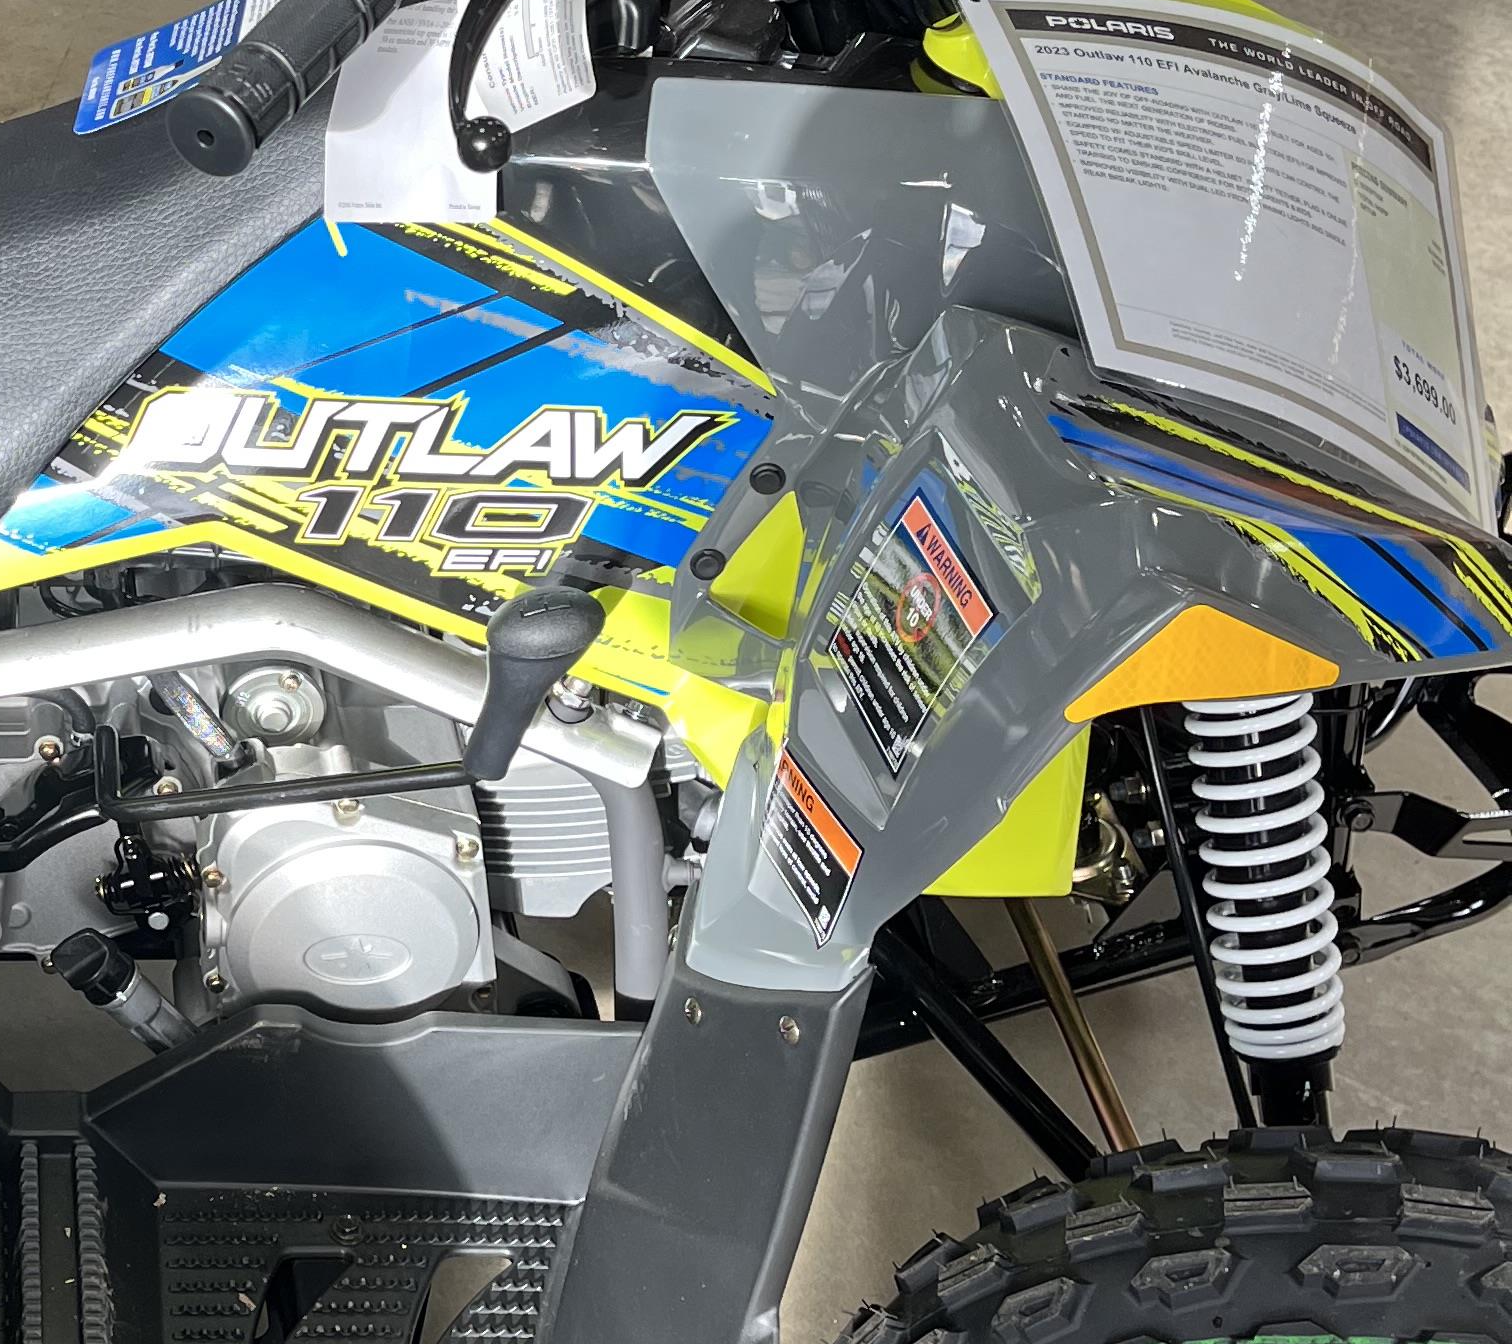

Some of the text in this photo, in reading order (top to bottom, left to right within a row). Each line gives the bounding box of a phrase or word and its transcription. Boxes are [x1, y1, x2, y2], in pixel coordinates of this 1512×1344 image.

[1045, 15, 1174, 40] POLARIS
[1035, 45, 1069, 56] 2023
[1074, 47, 1124, 62] Outlaw
[1129, 54, 1152, 67] 110
[1157, 59, 1179, 71] EFI
[1184, 64, 1249, 89] Avalanche
[1040, 72, 1158, 95] STANDARD FEATURES
[1208, 37, 1237, 53] THE
[1243, 47, 1294, 71] WORLD
[1299, 64, 1347, 95] LEADER
[1388, 115, 1411, 141] ROAD
[1394, 355, 1456, 425] $3,699.00
[126, 386, 737, 490] OUTLAW
[296, 483, 604, 547] 110
[438, 547, 569, 576] EFI
[926, 534, 973, 609] WARNING
[904, 607, 921, 628] 10
[909, 587, 933, 622] UNDER
